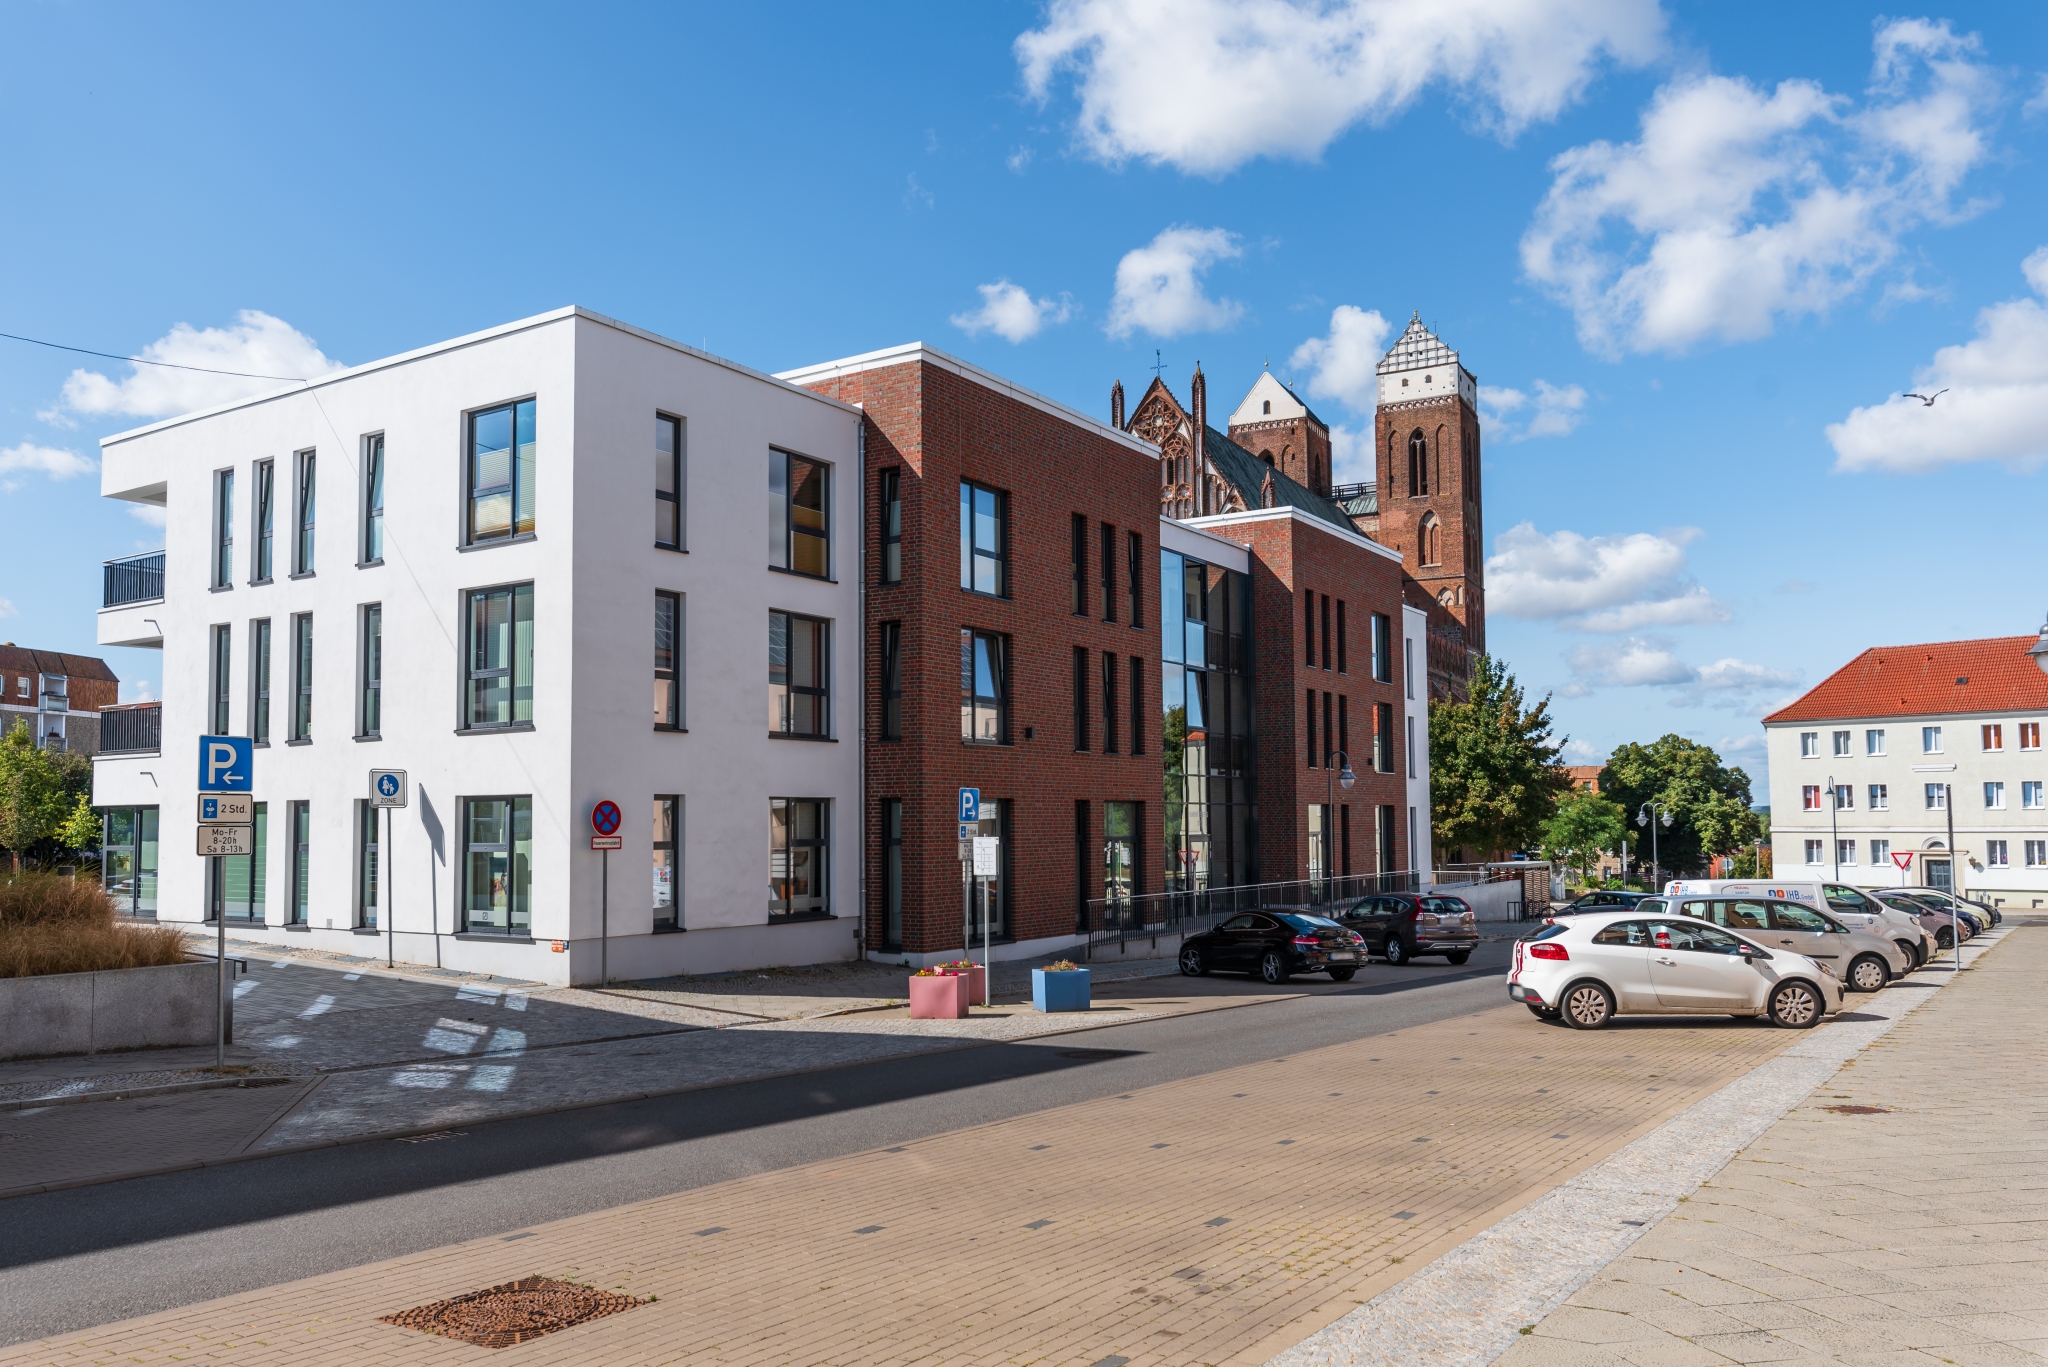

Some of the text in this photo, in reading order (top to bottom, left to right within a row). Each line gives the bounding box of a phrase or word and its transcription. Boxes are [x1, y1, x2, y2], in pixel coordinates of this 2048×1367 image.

[208, 743, 237, 784] P
[221, 804, 247, 814] 2 Std.
[962, 792, 974, 818] P
[212, 828, 238, 836] Mo-Fr
[213, 837, 237, 845] 8-20h
[207, 845, 243, 853] Sa 8-13h
